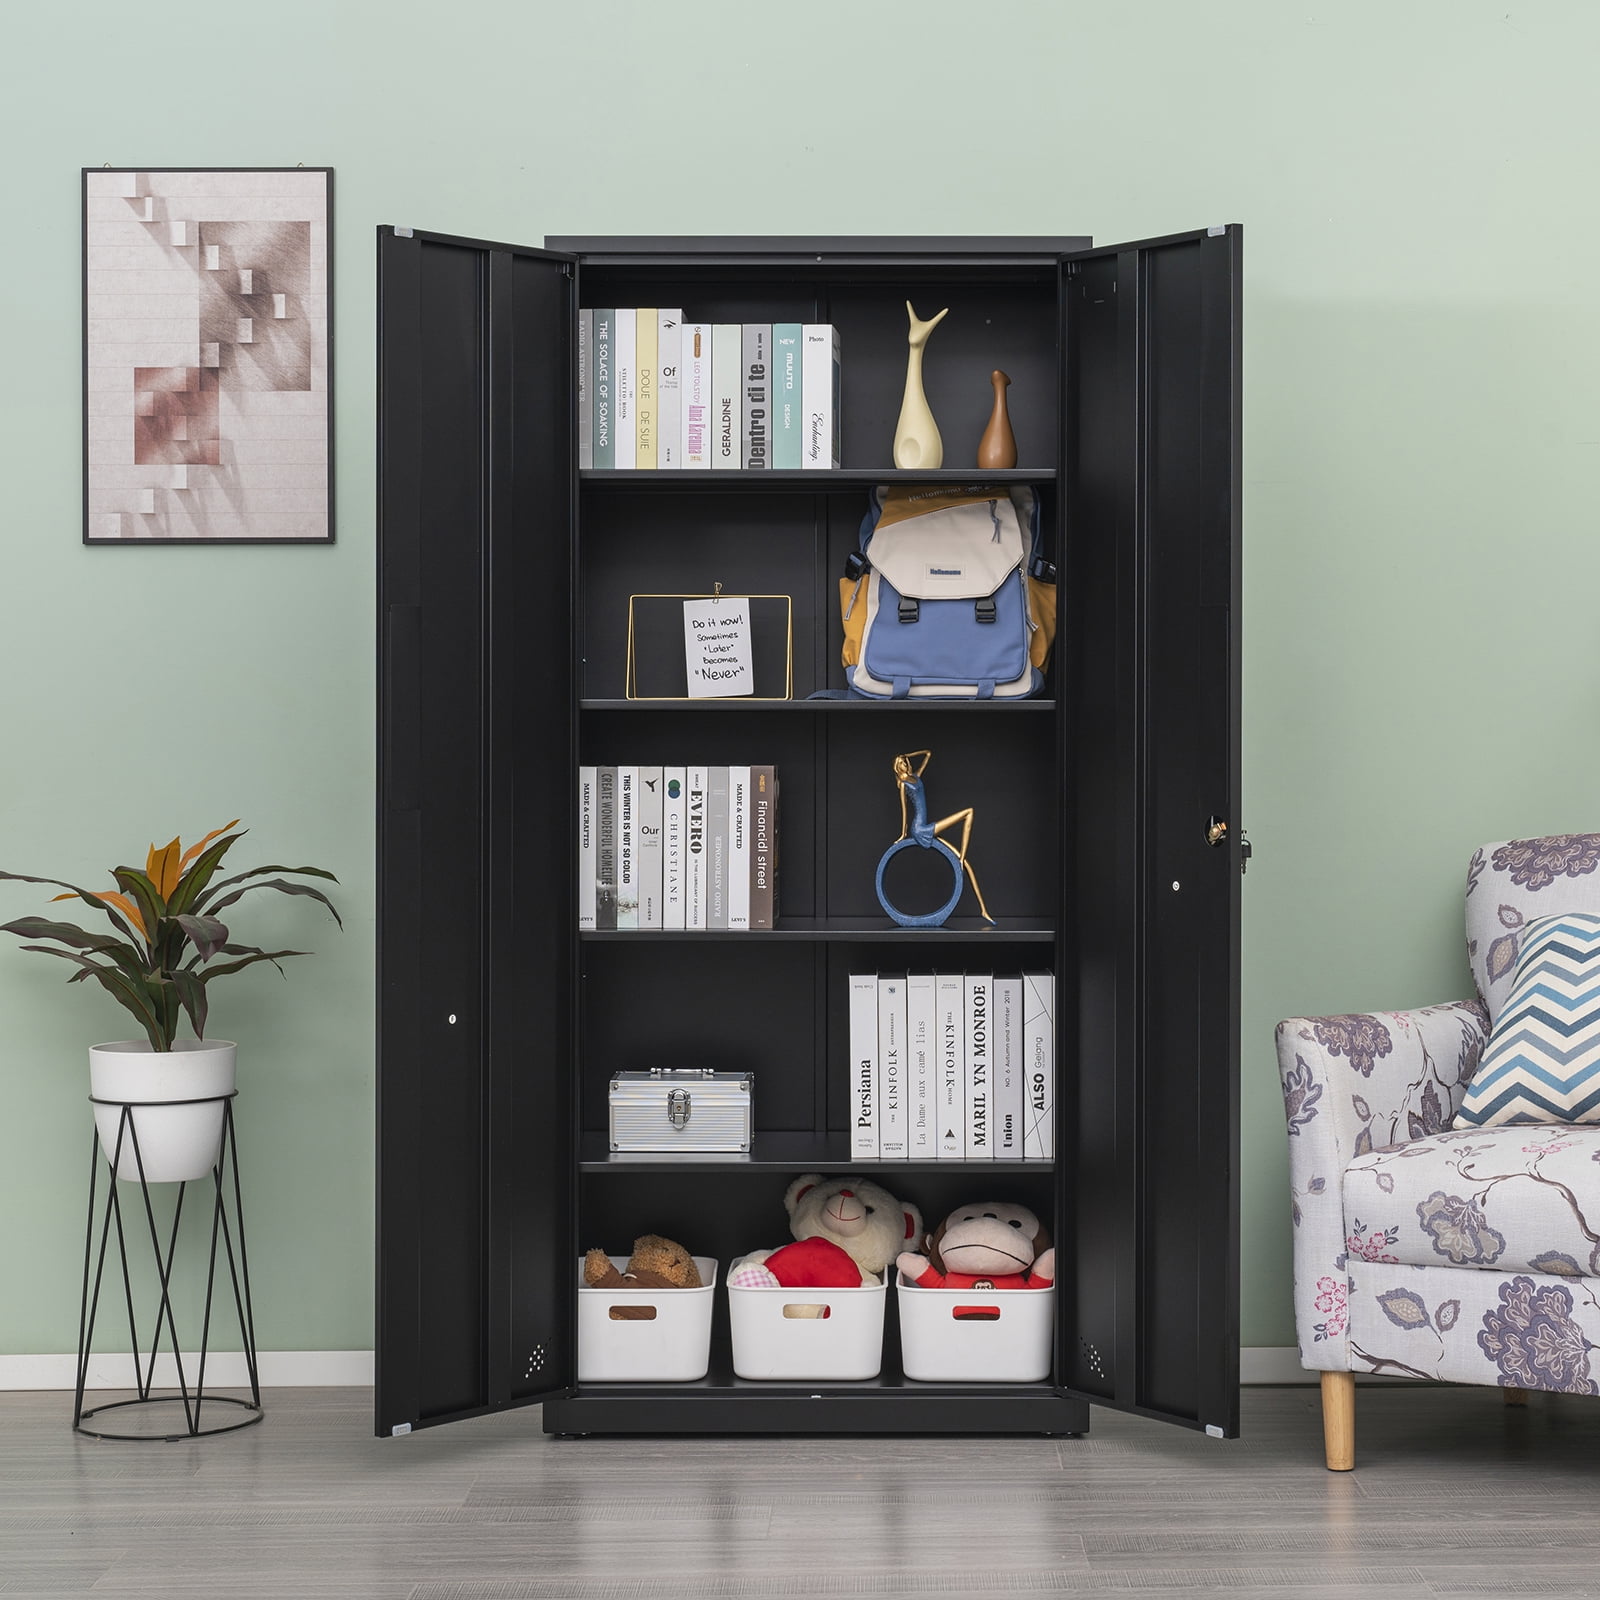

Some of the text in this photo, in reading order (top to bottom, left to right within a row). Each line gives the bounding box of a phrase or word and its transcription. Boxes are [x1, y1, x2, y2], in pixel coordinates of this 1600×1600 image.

[663, 367, 676, 376] Of
[693, 362, 701, 374] LEO
[599, 321, 608, 447] THE SOLACE OF SOAKING
[693, 376, 701, 403] TOLSTOY
[640, 411, 650, 424] DE
[688, 405, 706, 422] Anna
[748, 364, 765, 469] Dentro di te
[688, 424, 706, 454] Karenina
[722, 398, 731, 457] GERALDINE
[692, 614, 744, 629] Do it now!
[697, 632, 739, 641] Sometimes
[695, 666, 745, 680] "Never"
[623, 775, 631, 791] THIS
[623, 793, 631, 821] WINTER
[602, 773, 612, 885] CREATE WONDERFUL HOMELIFE
[641, 826, 659, 834] Our
[690, 790, 703, 854] EVERO
[623, 832, 631, 845] NOT
[623, 848, 631, 858] SO
[670, 813, 678, 903] CHRISTIANE
[623, 860, 631, 884] COLOD
[758, 856, 768, 889] street
[916, 1020, 925, 1044] lias
[917, 1050, 926, 1074] camé
[945, 1024, 955, 1087] KINFOLK
[974, 985, 985, 1147] MARIL YN MONROE
[888, 1049, 897, 1109] KINFOLK
[1033, 1037, 1045, 1111] ALSO Gelang
[858, 1060, 871, 1128] Persiana
[917, 1104, 926, 1127] Dame
[917, 1134, 927, 1145] La
[1003, 1114, 1012, 1148] Union
